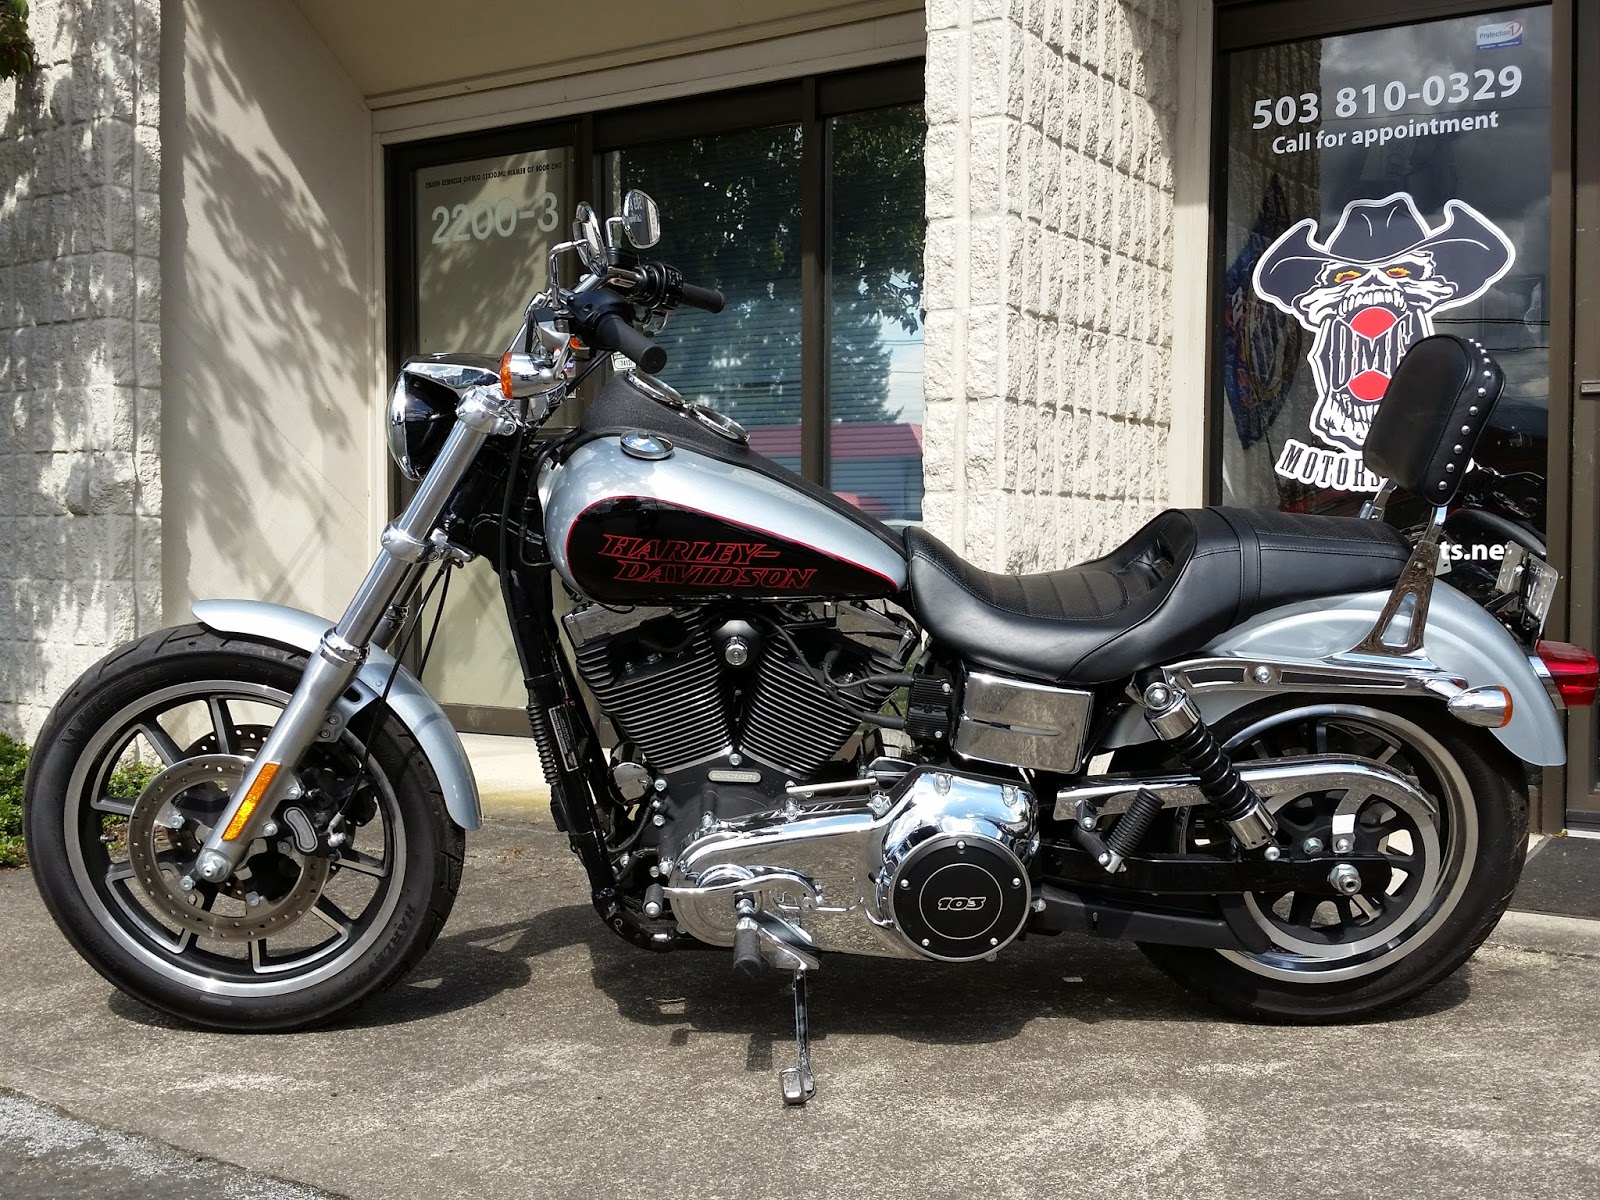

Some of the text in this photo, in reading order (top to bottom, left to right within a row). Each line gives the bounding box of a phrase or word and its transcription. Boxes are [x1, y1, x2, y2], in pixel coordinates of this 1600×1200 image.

[1252, 65, 1523, 130] 503 810-0329
[1272, 110, 1499, 154] Call for appointment
[431, 191, 560, 245] 2200-3
[613, 560, 818, 589] DAVIDSON
[937, 897, 987, 911] 103
